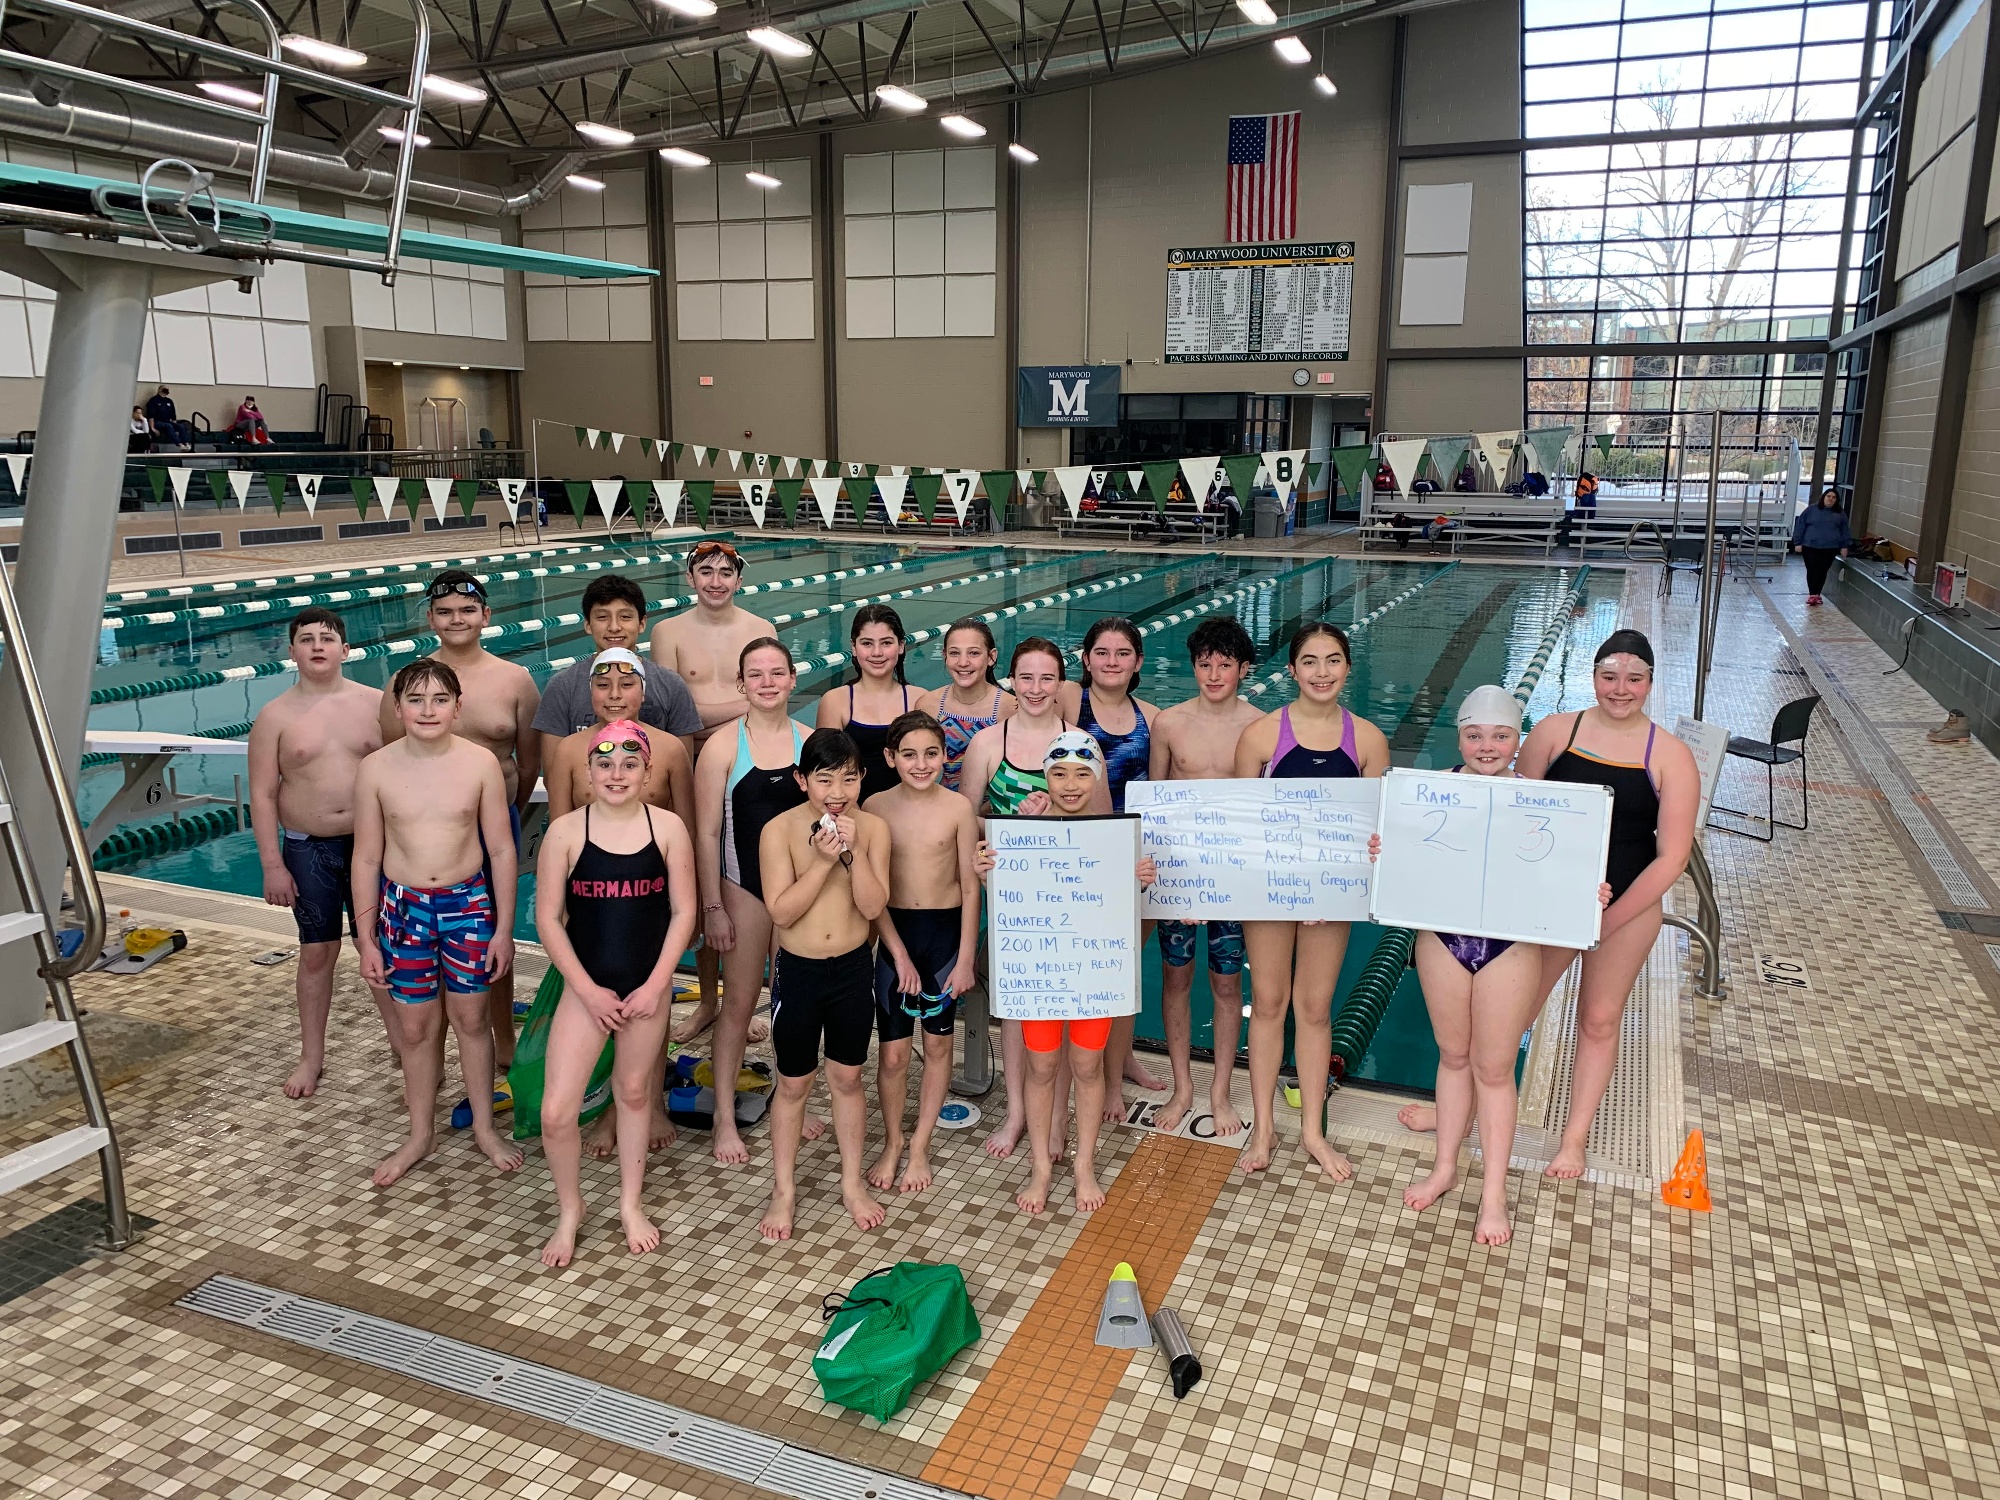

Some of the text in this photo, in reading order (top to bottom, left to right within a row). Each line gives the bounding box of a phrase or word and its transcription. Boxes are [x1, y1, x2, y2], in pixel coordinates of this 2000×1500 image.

[1186, 245, 1335, 261] MARYWOOD UNIVERSITY
[1202, 354, 1248, 362] SWIMMING
[1249, 353, 1268, 361] AND
[1269, 353, 1300, 361] DIVING
[1302, 352, 1343, 360] RECORDS
[1048, 371, 1091, 379] MARYWOOD
[1048, 379, 1090, 416] M
[660, 442, 665, 452] 1
[758, 456, 764, 466] 2
[1276, 456, 1293, 482] 8
[852, 465, 859, 475] 3
[1096, 473, 1103, 484] 5
[1215, 471, 1222, 481] 6
[305, 478, 315, 498] 4
[508, 483, 518, 504] 5
[751, 484, 763, 507] 6
[956, 478, 970, 502] 7
[1688, 734, 1701, 745] Free
[146, 782, 162, 806] 6
[1154, 784, 1198, 804] Rams
[1274, 782, 1332, 811] Bengals
[1416, 783, 1461, 806] RAMS
[1515, 791, 1571, 808] BENGALS
[1142, 811, 1227, 826] Ava Bella
[1261, 807, 1353, 829] Gabby Jason
[999, 827, 1072, 848] QUARTER 1
[1143, 830, 1189, 847] Mason
[1264, 828, 1355, 850] Brody Kellan
[1422, 809, 1468, 852] 2
[1514, 814, 1555, 863] 3
[527, 831, 540, 859] 7
[997, 856, 1101, 872] 200 Free For
[1198, 851, 1223, 865] Will
[1227, 852, 1246, 871] Kap
[1317, 848, 1352, 864] Alex
[1052, 872, 1084, 884] Time
[1152, 874, 1216, 888] lexandra
[1267, 870, 1369, 898] Hadley Gregory
[572, 879, 651, 898] MERMAID
[999, 889, 1104, 907] 400 Free Relay
[1148, 890, 1232, 910] Kacey Chloe
[1268, 891, 1314, 911] Meghan
[997, 912, 1073, 929] QUARTER 2
[1000, 937, 1033, 953] 200
[1039, 936, 1058, 953] IM
[1002, 958, 1123, 975] 400 MEDLEY RELAY
[999, 977, 1068, 990] QUARTER 3
[1002, 995, 1026, 1006] 200
[1034, 994, 1065, 1005] Free
[1086, 991, 1126, 1004] paddles
[1006, 1006, 1110, 1018] 200 Free Relay
